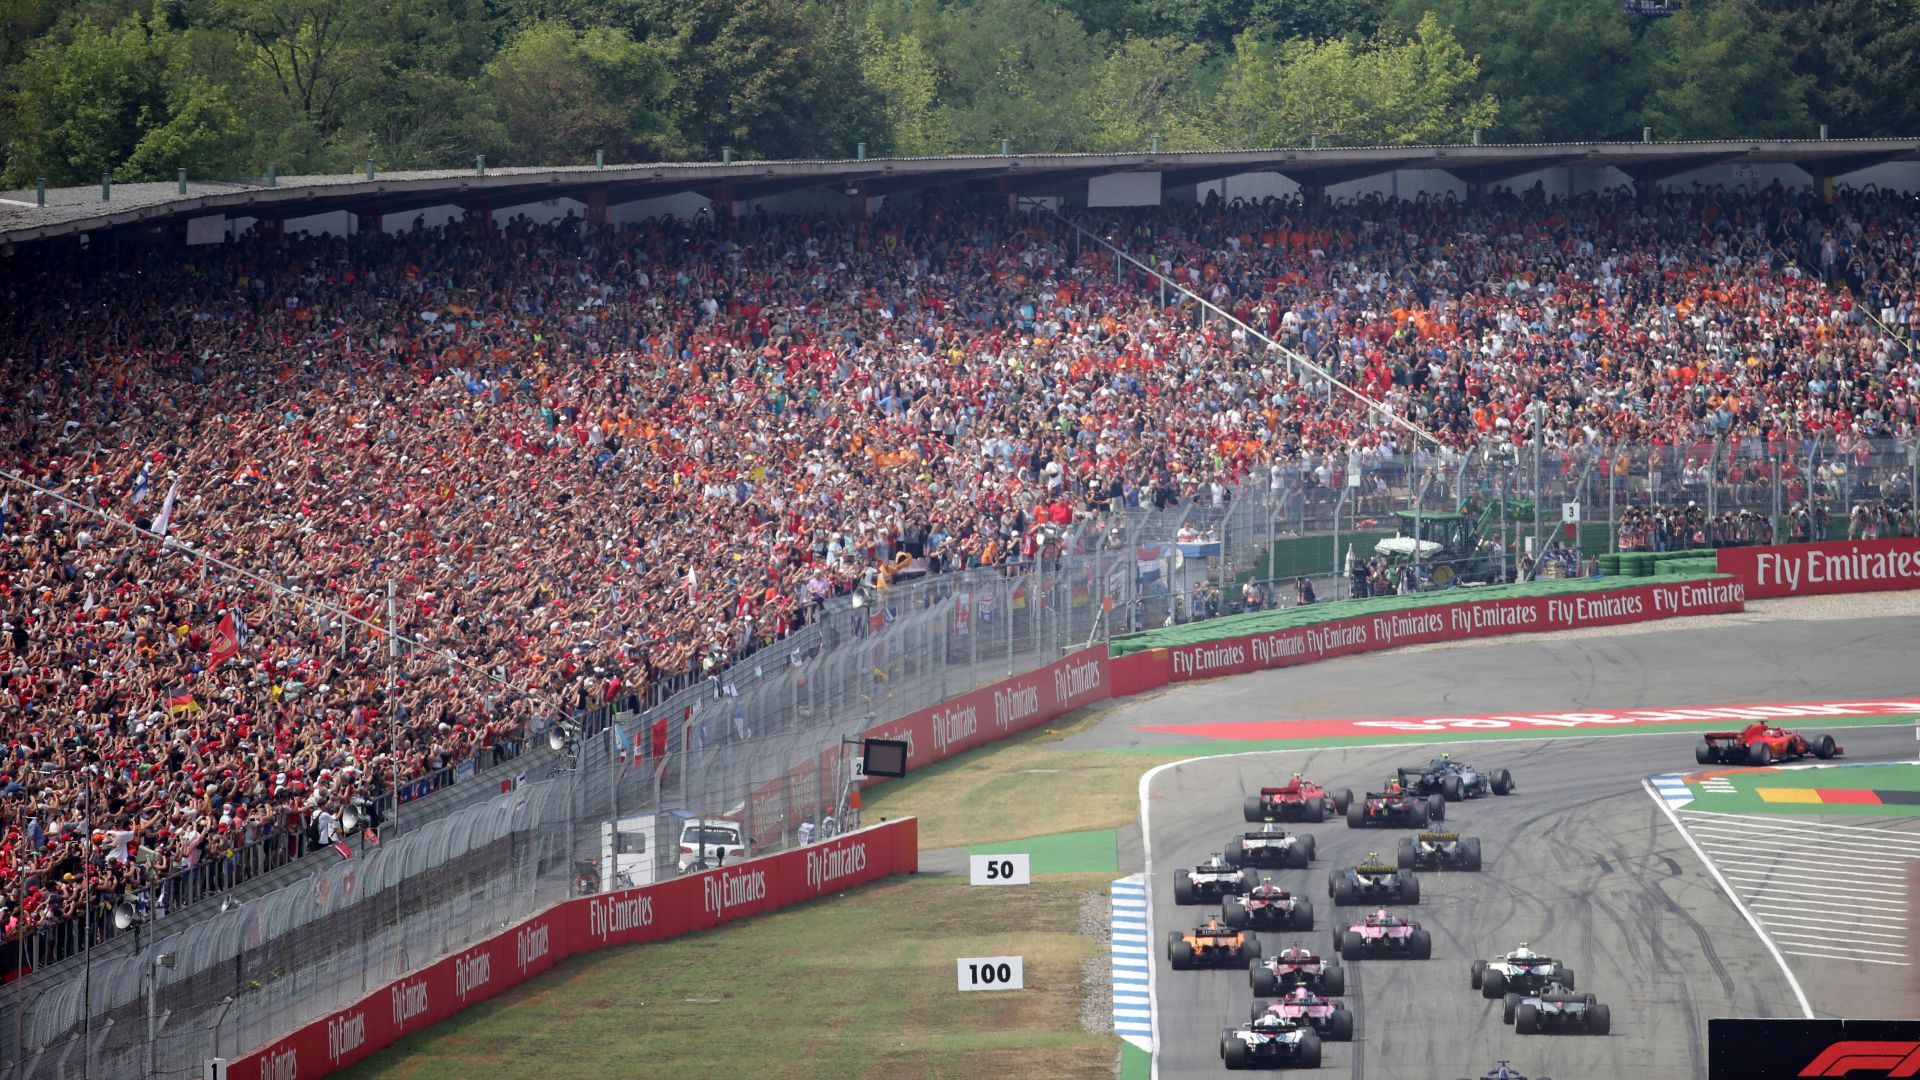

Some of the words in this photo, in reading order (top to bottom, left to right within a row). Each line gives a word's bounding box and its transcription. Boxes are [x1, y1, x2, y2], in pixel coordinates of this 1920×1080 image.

[1568, 506, 1574, 517] 3
[1756, 552, 1800, 591] Fly
[1807, 546, 1920, 583] Emirates
[1548, 599, 1575, 625] Fly
[1576, 594, 1643, 620] Emirates
[1652, 588, 1679, 613] Fly
[1373, 617, 1391, 642] Fly
[1392, 612, 1444, 637] Emirates
[1451, 607, 1471, 633] Fly
[1473, 603, 1537, 628] Emirates
[1251, 638, 1270, 663] Fly
[1270, 633, 1305, 657] Emirates
[1307, 628, 1323, 655] Fly
[1324, 624, 1367, 649] Emirates
[1173, 650, 1194, 675] Fly
[1195, 644, 1245, 669] Emirates
[1054, 669, 1068, 707] Fly
[1066, 658, 1100, 697] Emirates
[994, 690, 1008, 731] Fly
[1007, 682, 1038, 721] Emirates
[932, 712, 946, 754] Fly
[945, 704, 977, 743] Emirates
[856, 763, 862, 776] 2
[806, 851, 822, 891] Fly
[823, 842, 866, 881] Emirates
[986, 860, 1014, 879] 50
[703, 875, 721, 917] Fly
[722, 867, 766, 909] Emirates
[590, 899, 607, 941] Fly
[608, 890, 653, 932] Emirates
[517, 931, 528, 974] Fly
[527, 922, 549, 962] Emirates
[456, 957, 467, 1002] Fly
[466, 948, 491, 991] Emirates
[969, 963, 1011, 984] 100
[392, 985, 403, 1030] Fly
[402, 977, 428, 1019] Emirates
[328, 1019, 340, 1066] Fly
[339, 1010, 365, 1054] Emirates
[211, 1063, 218, 1080] 1
[271, 1044, 297, 1080] Emirates
